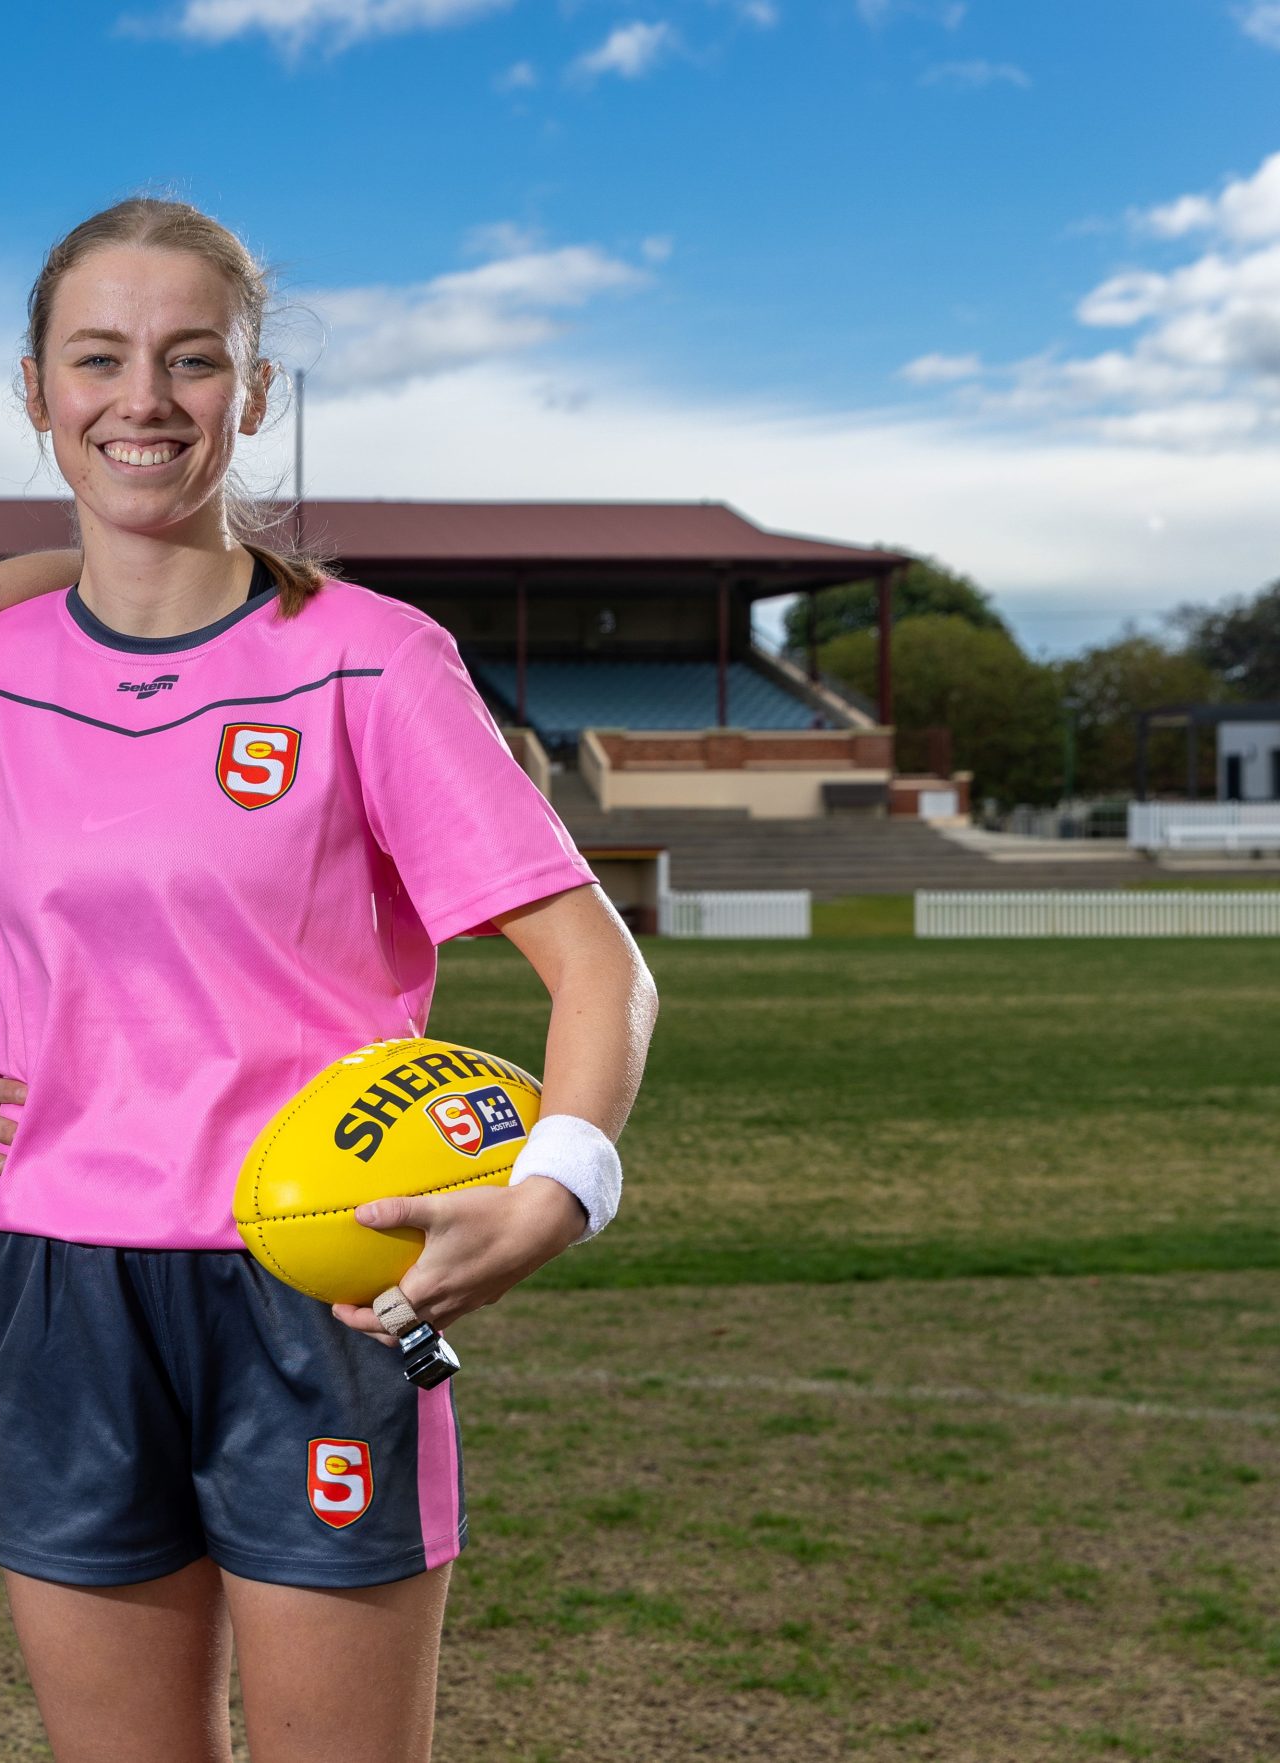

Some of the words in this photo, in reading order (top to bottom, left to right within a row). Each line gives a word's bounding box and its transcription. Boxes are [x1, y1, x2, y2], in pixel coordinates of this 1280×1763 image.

[116, 682, 173, 692] Sekem
[225, 729, 289, 796] S
[490, 1119, 518, 1132] HOSTPLUS
[313, 1443, 366, 1513] S
